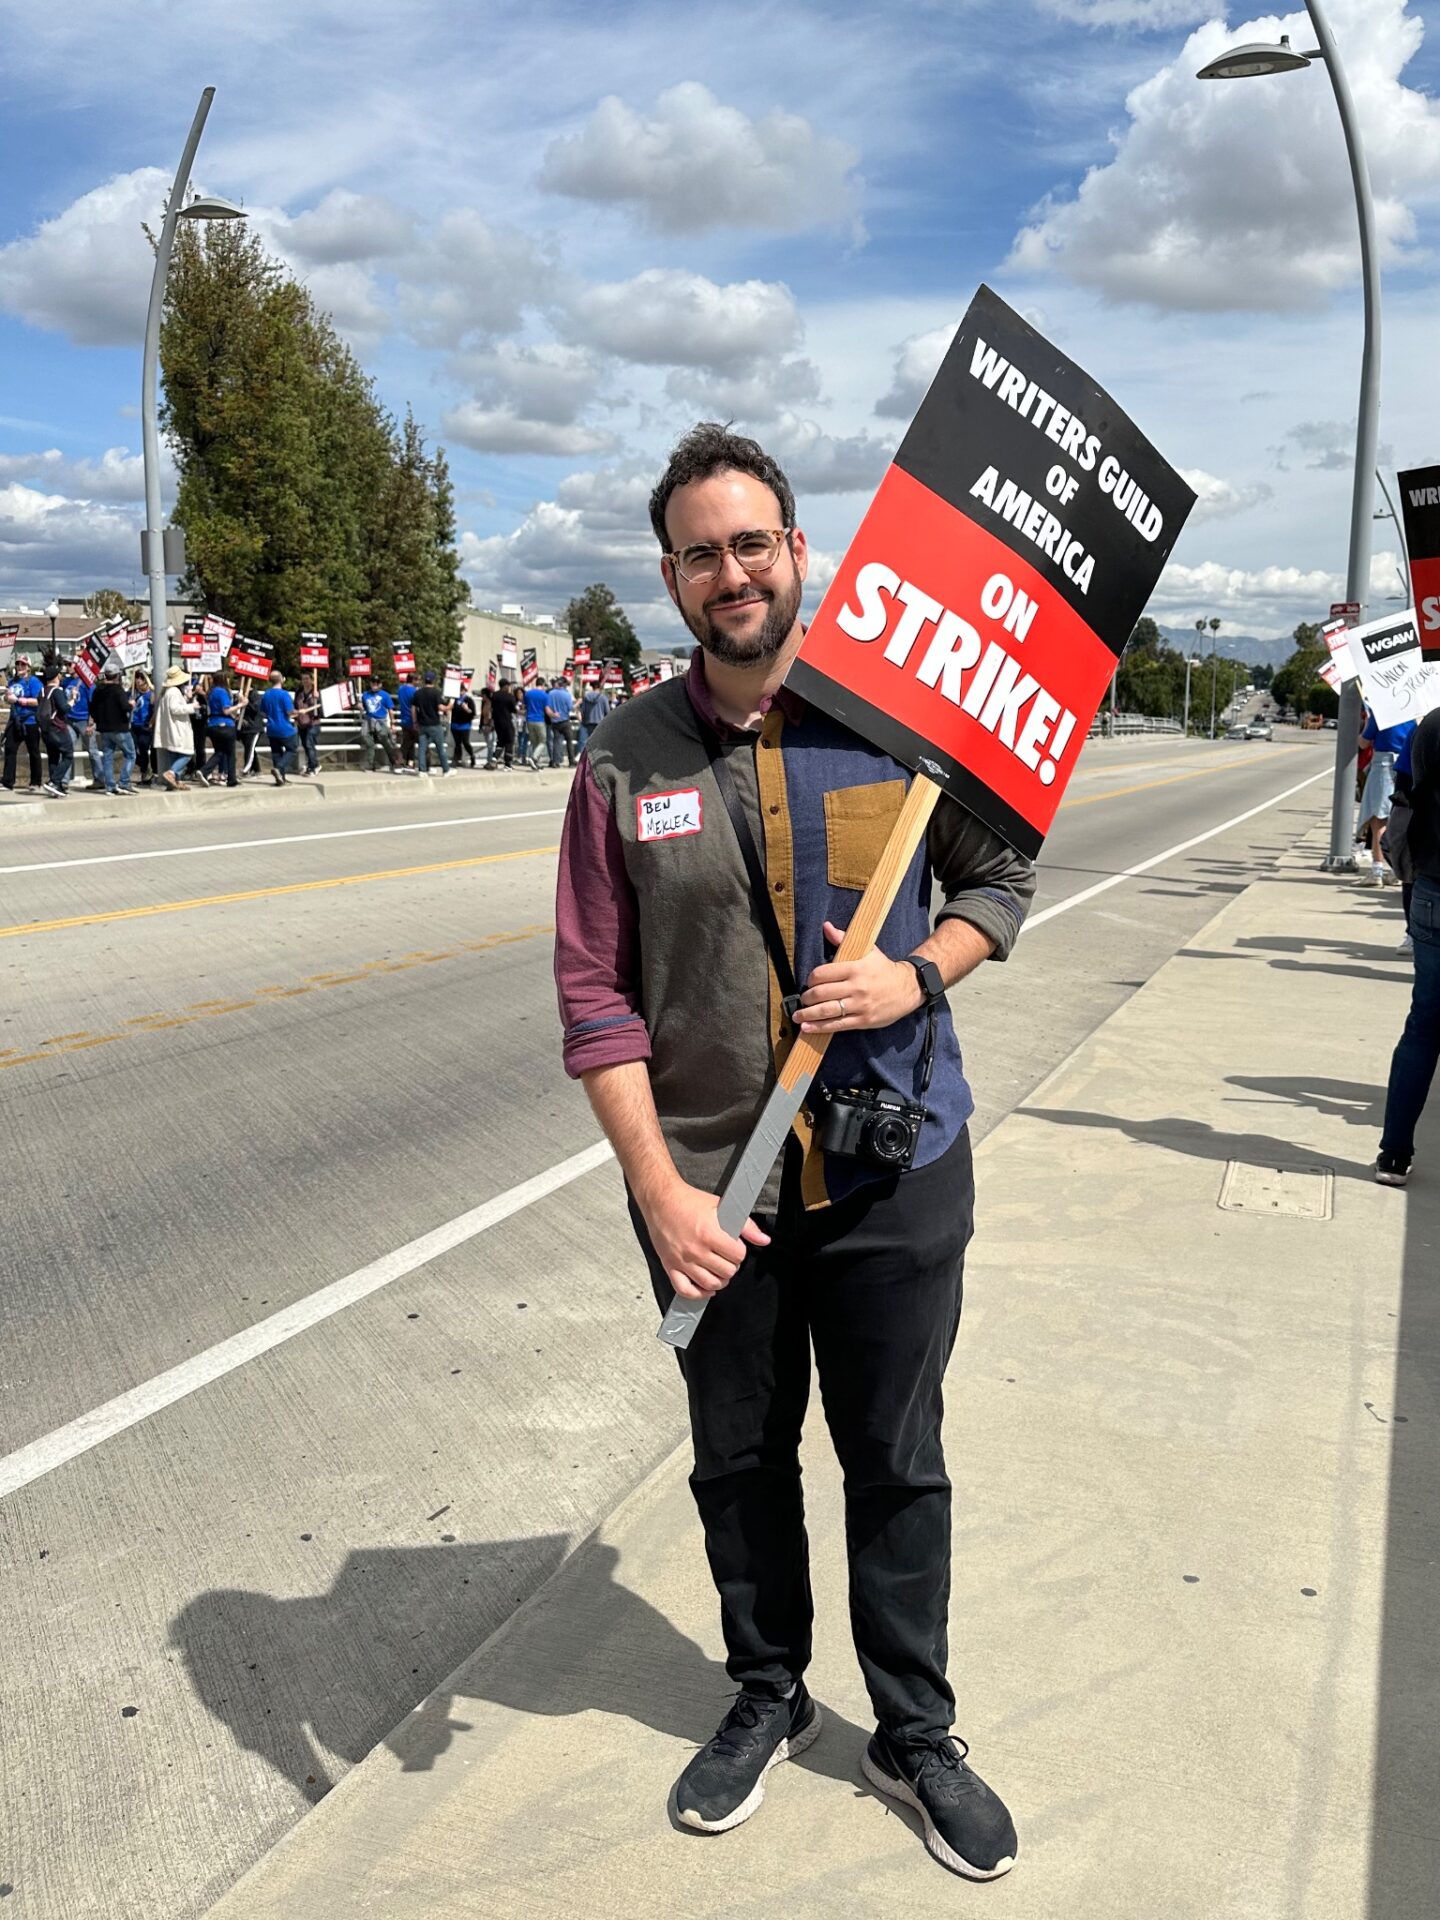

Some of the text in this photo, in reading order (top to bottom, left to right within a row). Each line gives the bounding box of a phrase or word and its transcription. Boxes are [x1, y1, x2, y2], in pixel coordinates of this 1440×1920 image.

[969, 337, 1164, 543] WRITERS GUILD
[1045, 464, 1080, 506] OF
[969, 465, 1097, 595] AMERICA
[980, 573, 1039, 644] ON
[1421, 595, 1440, 631] S
[1365, 629, 1414, 655] WGAW
[835, 562, 1077, 786] STRIKE!
[1370, 660, 1409, 689] UNION
[643, 797, 671, 814] BEN
[647, 813, 697, 836] MEKLER
